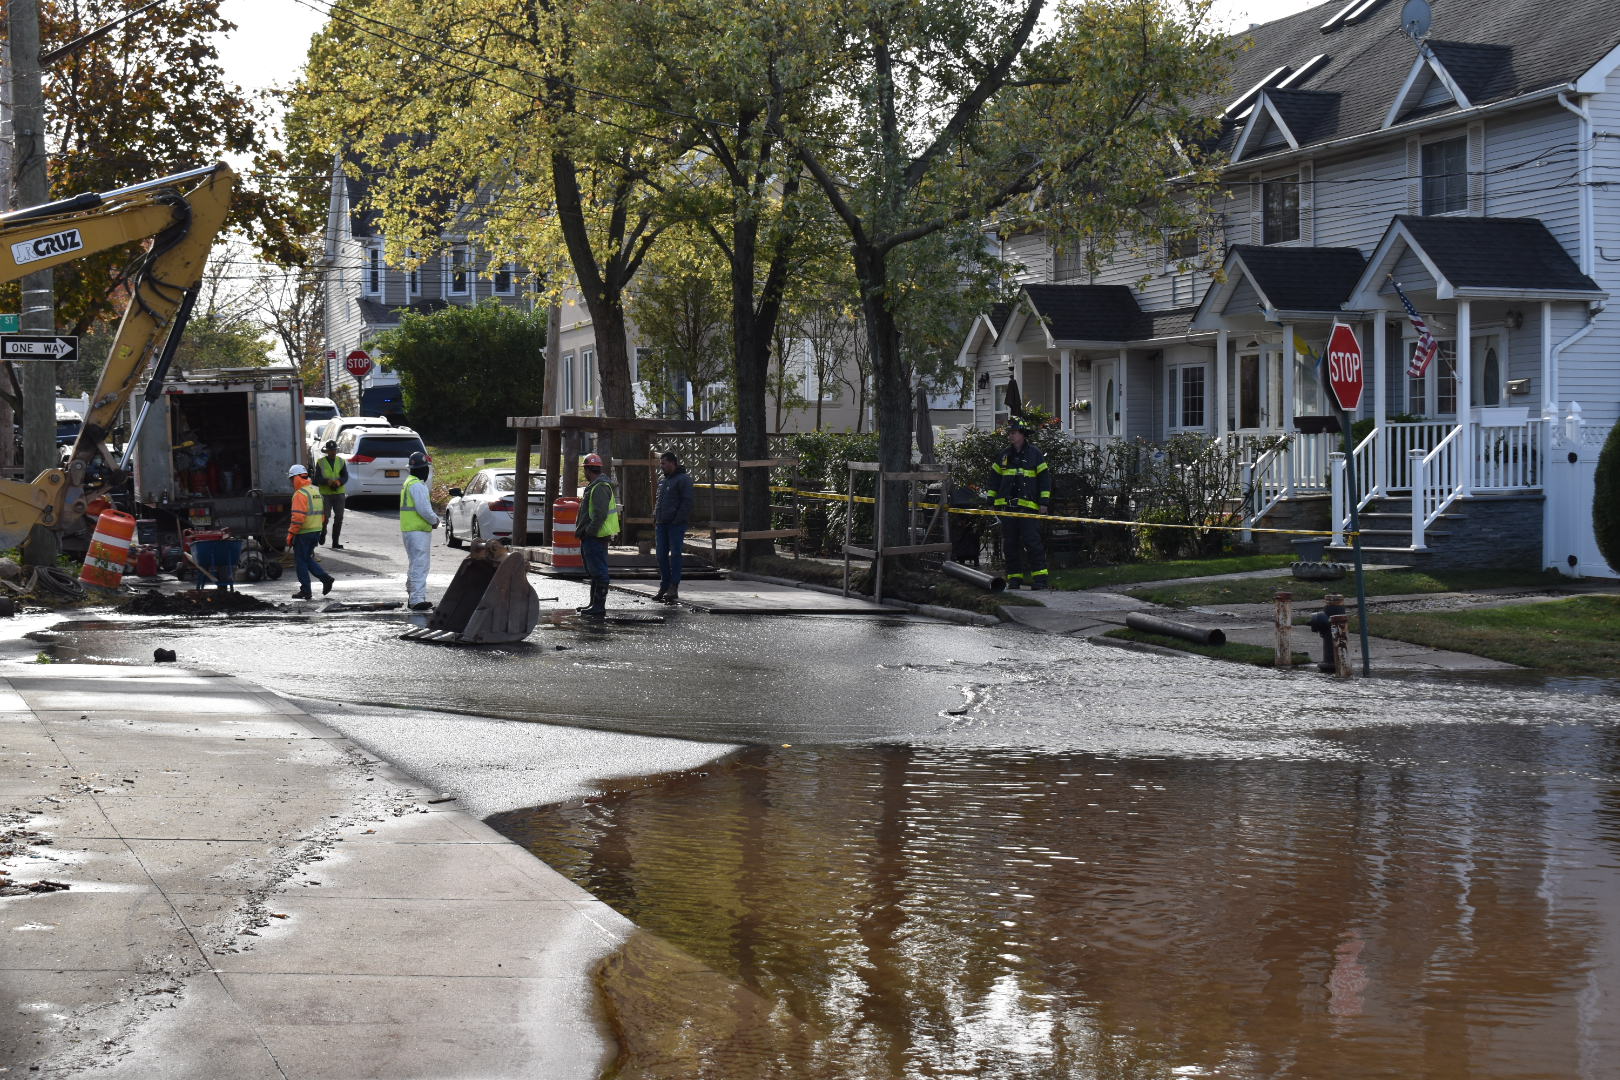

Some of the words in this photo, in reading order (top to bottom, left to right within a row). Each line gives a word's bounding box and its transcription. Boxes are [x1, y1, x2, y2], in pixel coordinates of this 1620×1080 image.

[4, 316, 14, 325] ST
[12, 343, 34, 353] ONE
[44, 342, 66, 354] WAY
[347, 358, 370, 369] STOP
[1330, 351, 1360, 383] STOP
